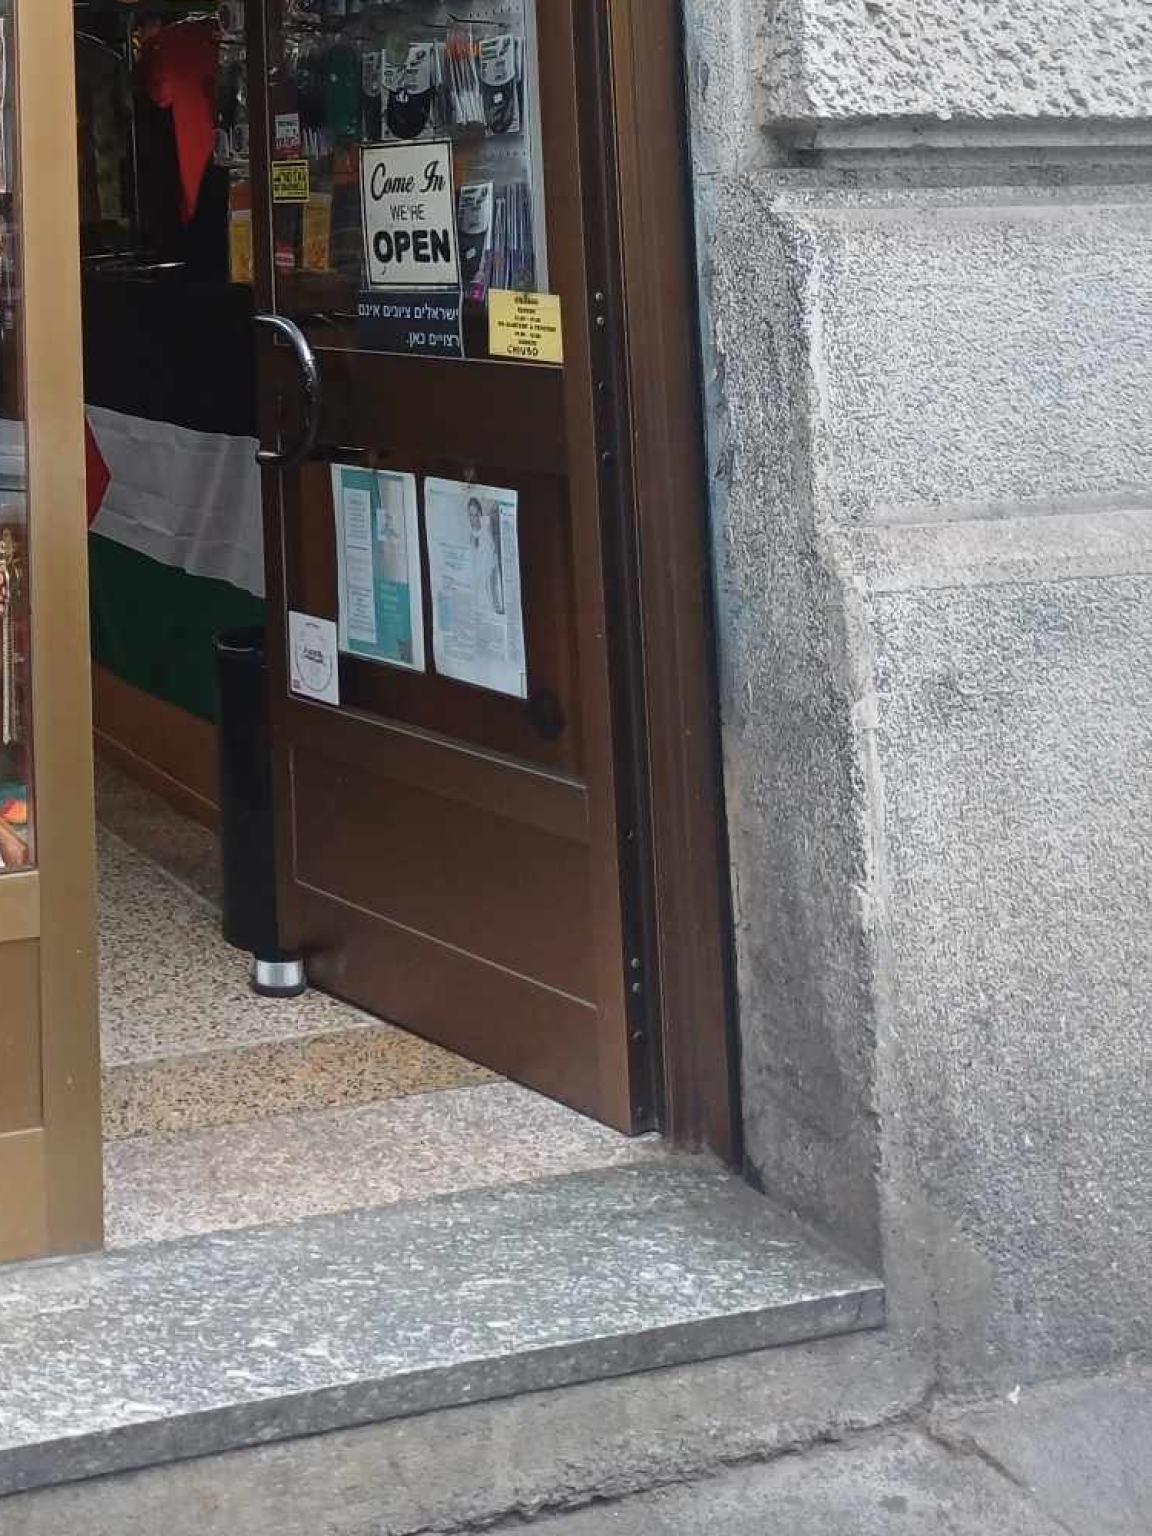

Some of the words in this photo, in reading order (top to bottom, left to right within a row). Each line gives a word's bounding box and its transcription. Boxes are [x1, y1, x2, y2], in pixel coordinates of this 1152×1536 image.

[370, 161, 415, 202] Come
[419, 159, 446, 193] In
[389, 203, 426, 222] WE'RE
[372, 229, 452, 265] OPEN
